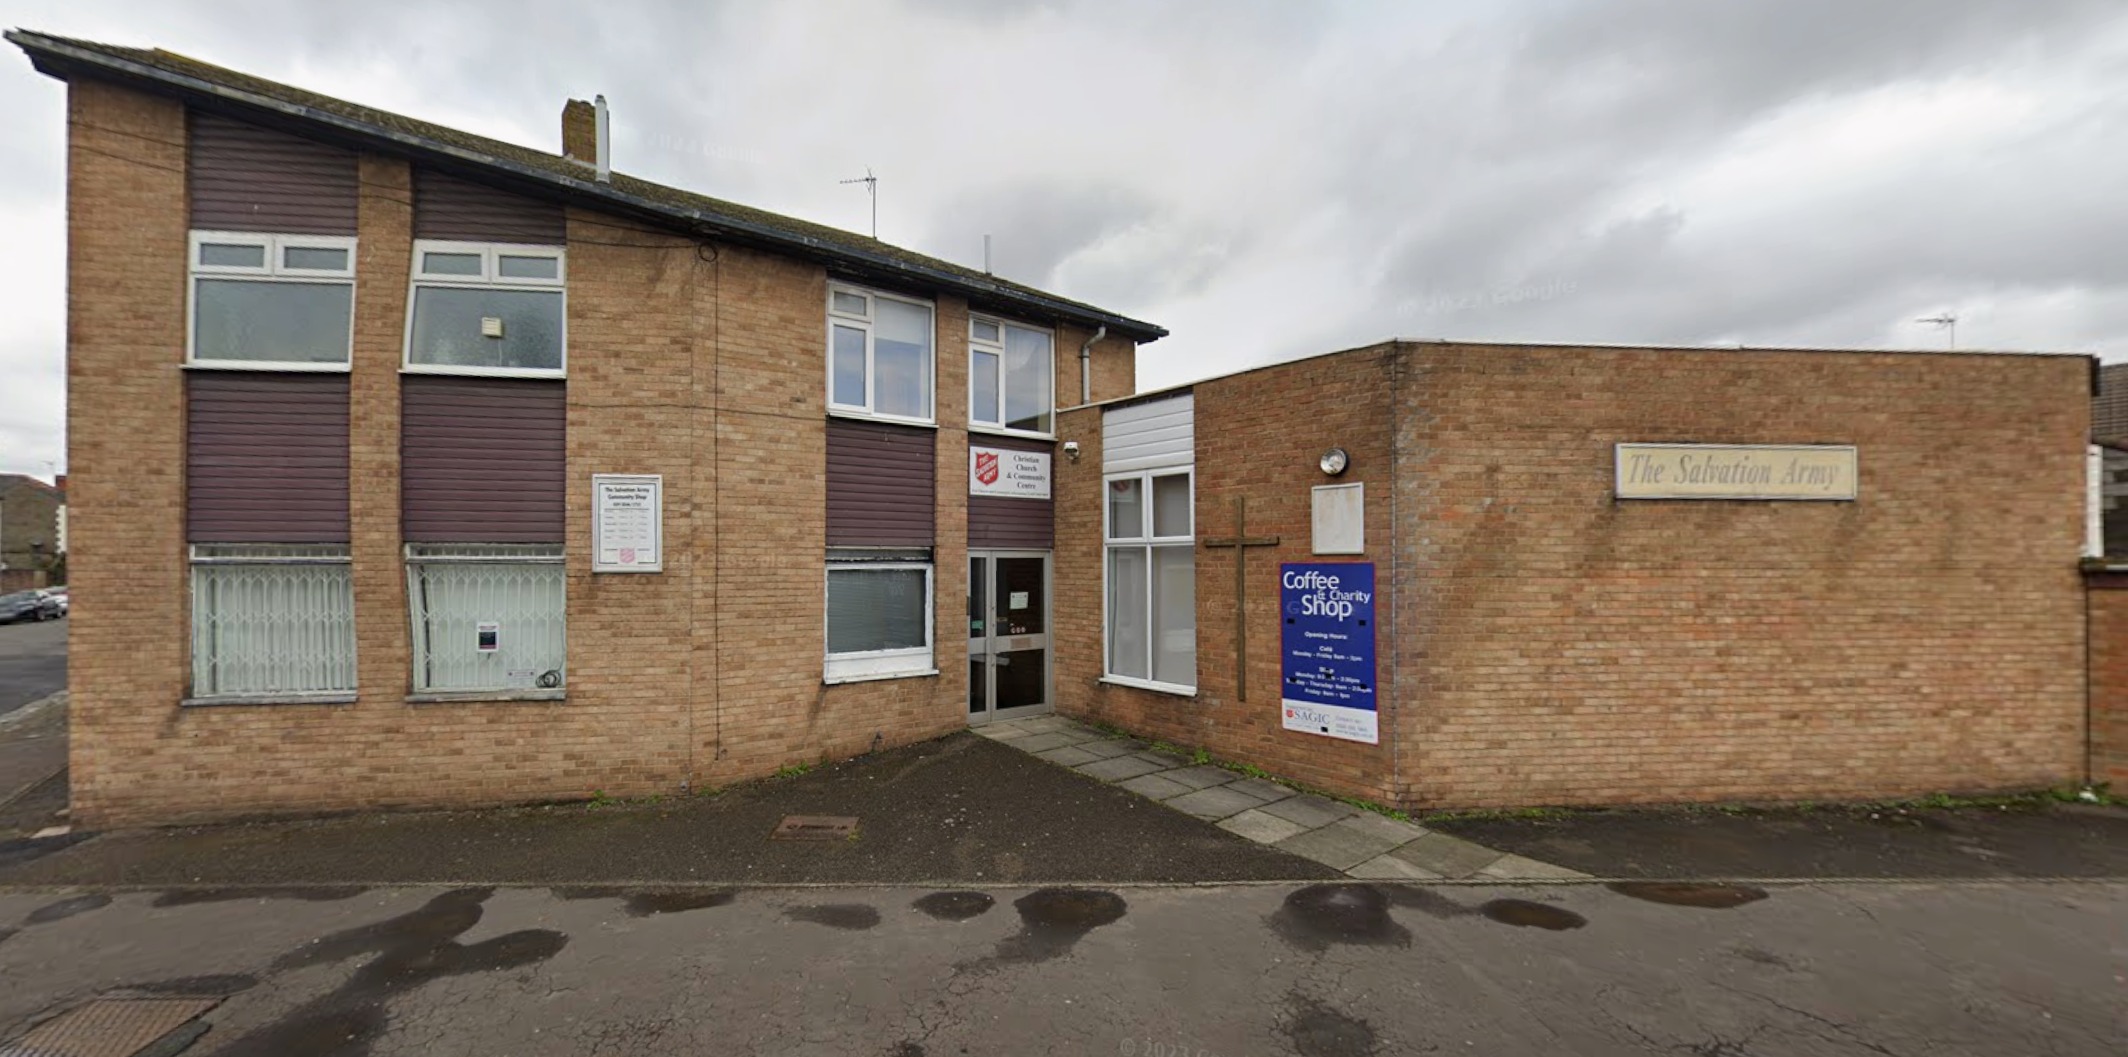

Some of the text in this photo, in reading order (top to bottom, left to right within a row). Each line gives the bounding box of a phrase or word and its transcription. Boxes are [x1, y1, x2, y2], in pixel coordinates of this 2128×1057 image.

[1013, 455, 1040, 463] Christian
[1016, 464, 1037, 472] Church
[1628, 454, 1841, 490] The Salvation Army
[1014, 474, 1046, 482] Community
[1282, 571, 1340, 590] Coffee
[1317, 588, 1371, 604] & Charity
[1301, 594, 1352, 622] Shop
[1304, 631, 1328, 640] Opening
[1294, 708, 1330, 724] SAGIC
